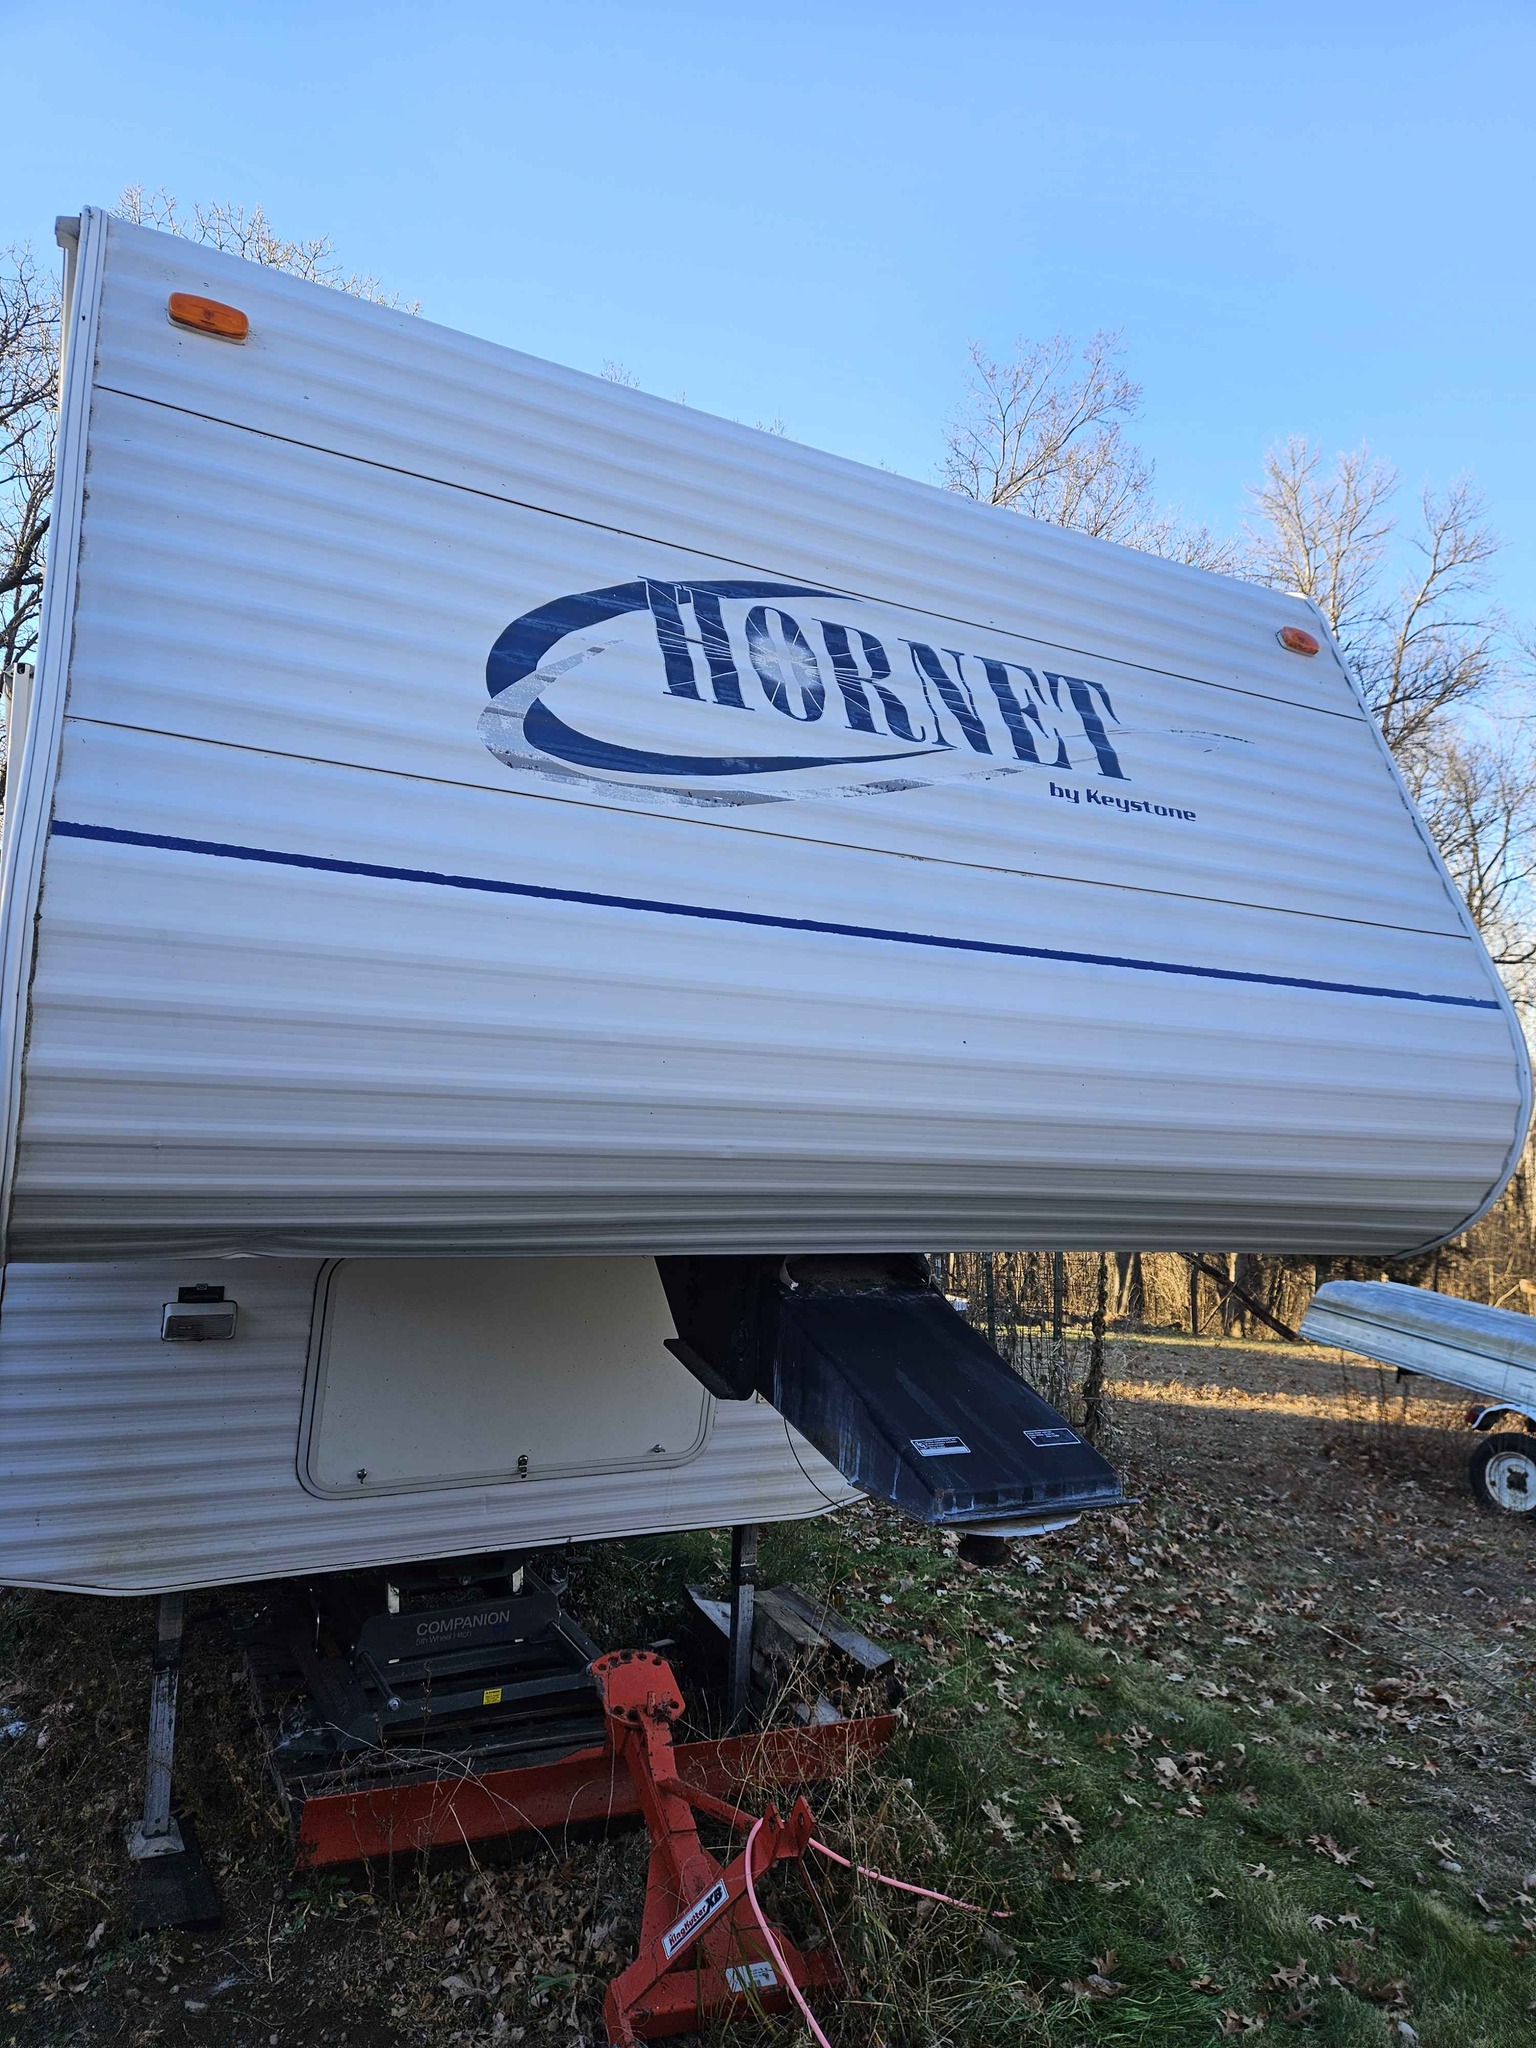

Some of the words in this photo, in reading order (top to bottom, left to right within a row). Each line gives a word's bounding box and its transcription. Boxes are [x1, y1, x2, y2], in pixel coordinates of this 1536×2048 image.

[637, 575, 1131, 782] HORNET
[1049, 781, 1080, 804] by
[1086, 788, 1197, 822] Keystone
[416, 1609, 510, 1636] COMPANION
